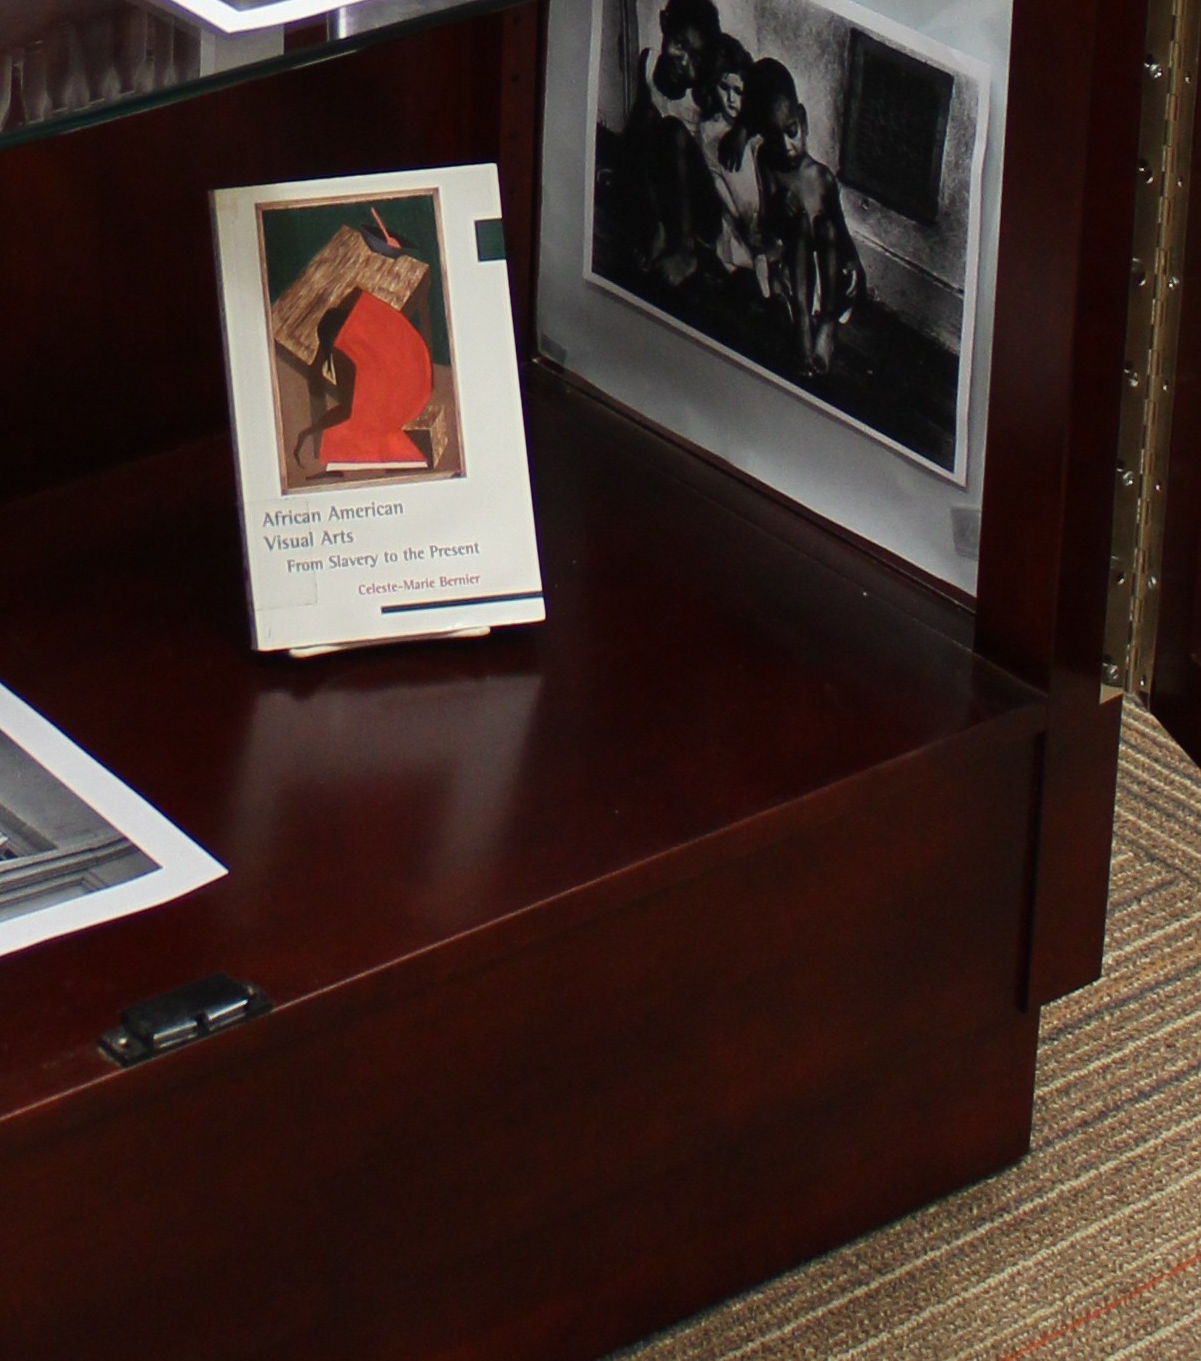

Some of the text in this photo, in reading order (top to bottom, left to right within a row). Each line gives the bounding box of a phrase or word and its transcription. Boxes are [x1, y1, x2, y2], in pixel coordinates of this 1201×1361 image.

[263, 502, 403, 527] African American
[263, 530, 354, 551] Visual Arts
[287, 542, 479, 573] From Slavery to the Present
[358, 574, 480, 595] Celeste-Marie Bernier
